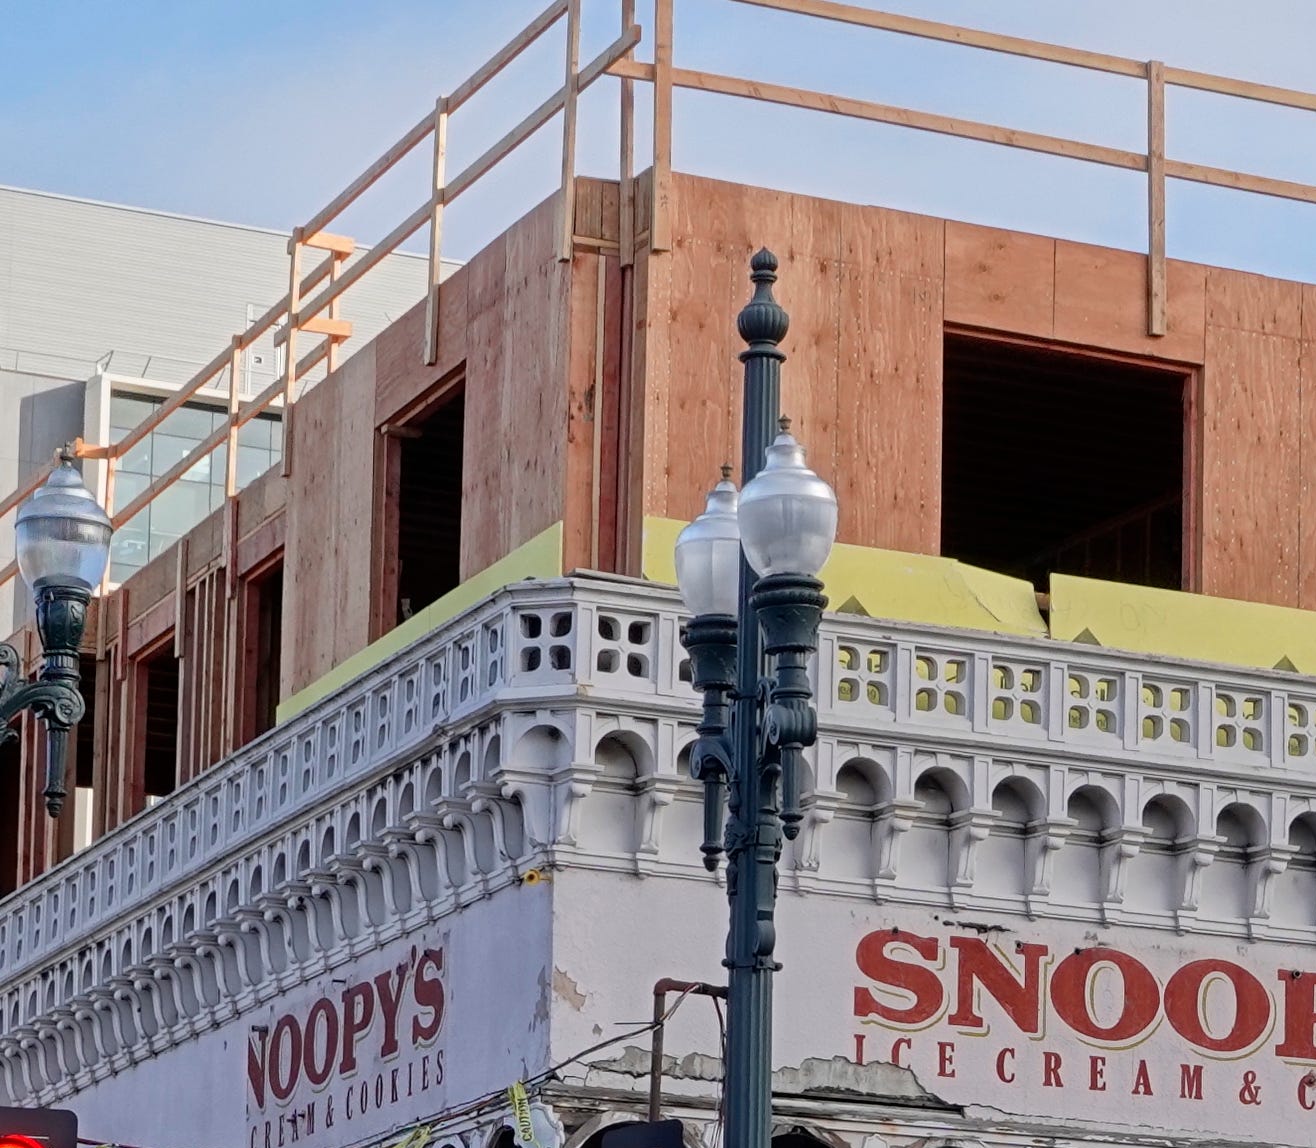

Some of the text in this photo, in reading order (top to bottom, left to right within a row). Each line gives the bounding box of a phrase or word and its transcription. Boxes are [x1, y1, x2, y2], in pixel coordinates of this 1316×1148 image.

[247, 944, 445, 1109] NOOPY'S
[325, 1095, 334, 1129] &
[346, 1050, 444, 1120] COOKIES
[853, 1033, 956, 1078] ICE
[995, 1047, 1203, 1101] CREAM
[1238, 1070, 1262, 1106] &
